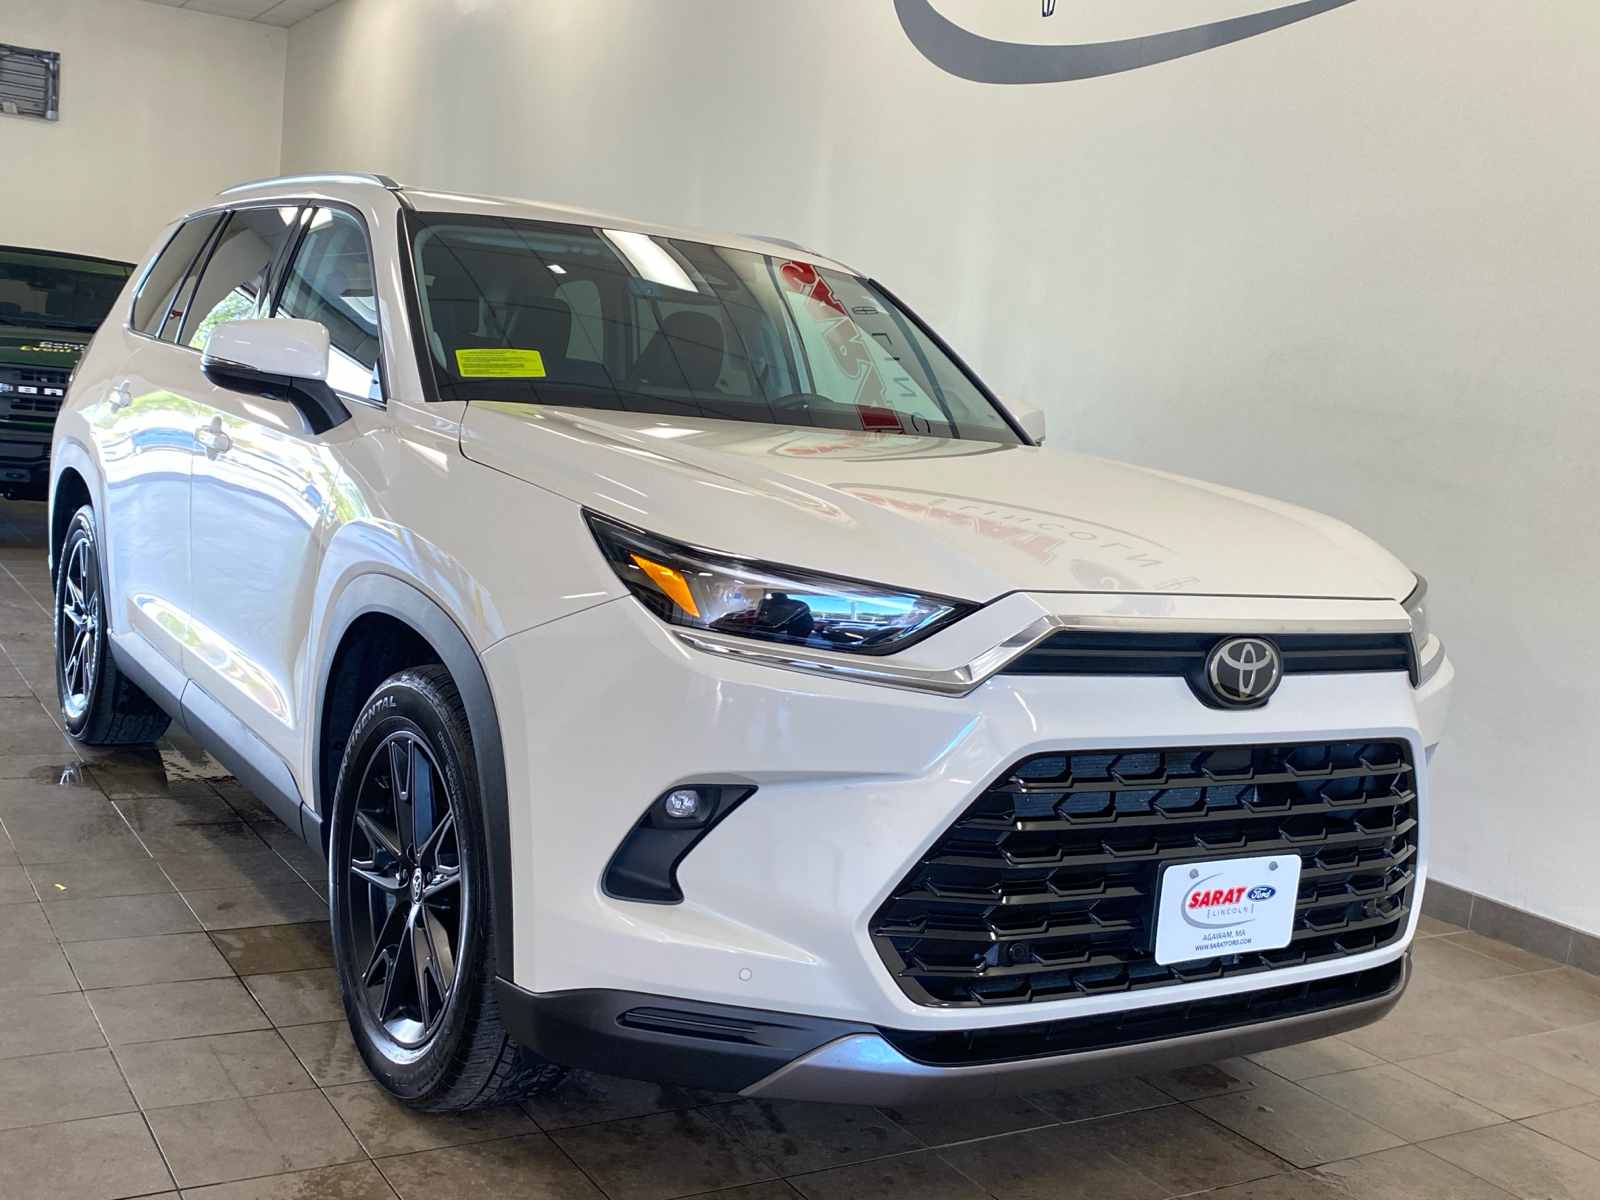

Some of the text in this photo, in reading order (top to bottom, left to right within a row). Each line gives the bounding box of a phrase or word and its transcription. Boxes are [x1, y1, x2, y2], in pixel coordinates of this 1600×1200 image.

[1187, 885, 1273, 909] SARAT Ford
[1212, 906, 1248, 917] LINCOLN
[1202, 929, 1246, 942] AGAWAM, MA
[1194, 938, 1252, 951] WWW.SARATFORD.COM
